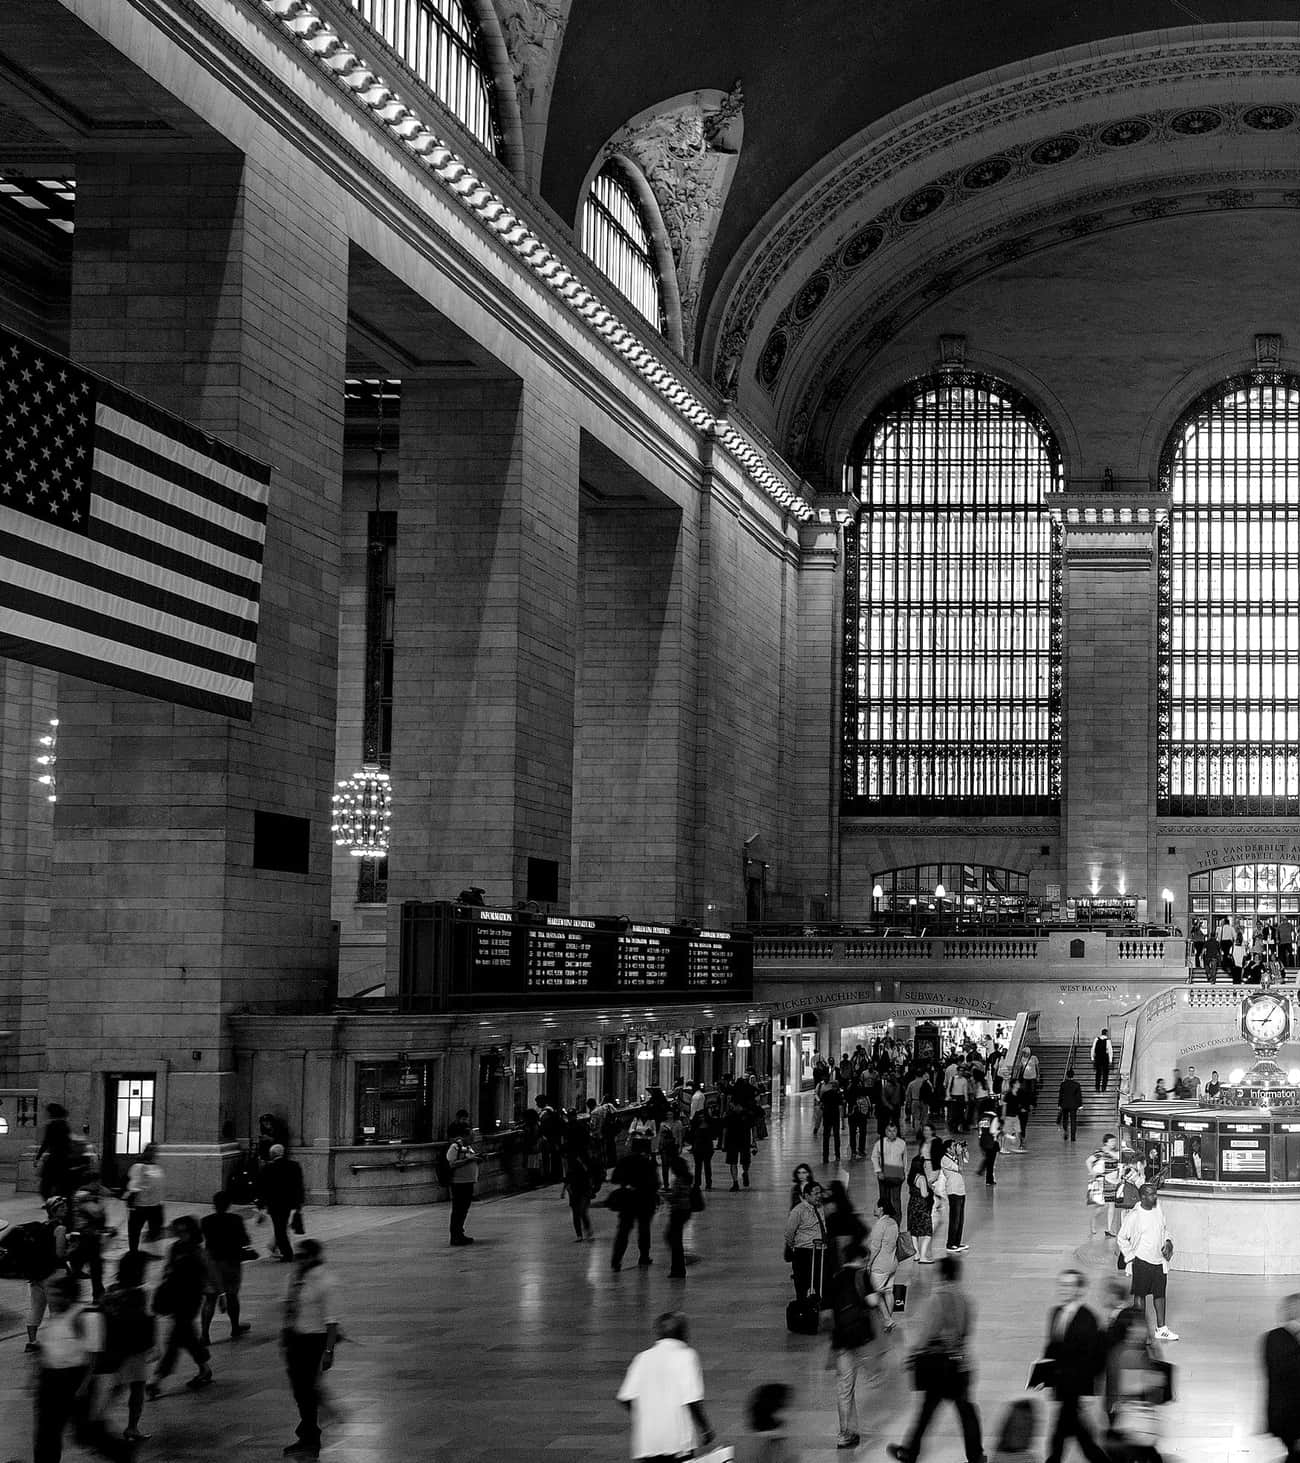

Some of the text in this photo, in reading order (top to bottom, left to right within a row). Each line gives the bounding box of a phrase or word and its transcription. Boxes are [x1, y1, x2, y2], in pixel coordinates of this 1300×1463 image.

[1206, 849, 1218, 858] TO
[1223, 844, 1285, 854] VANDERBILT
[1197, 857, 1218, 868] THE
[1222, 852, 1275, 863] CAMPBELL
[775, 991, 871, 1011] TICKET MACHINES
[904, 991, 993, 1011] SUBWAY 42ND ST
[891, 1008, 926, 1017] SUBWAY
[1180, 1042, 1206, 1055] DINING
[1250, 1089, 1296, 1098] Information
